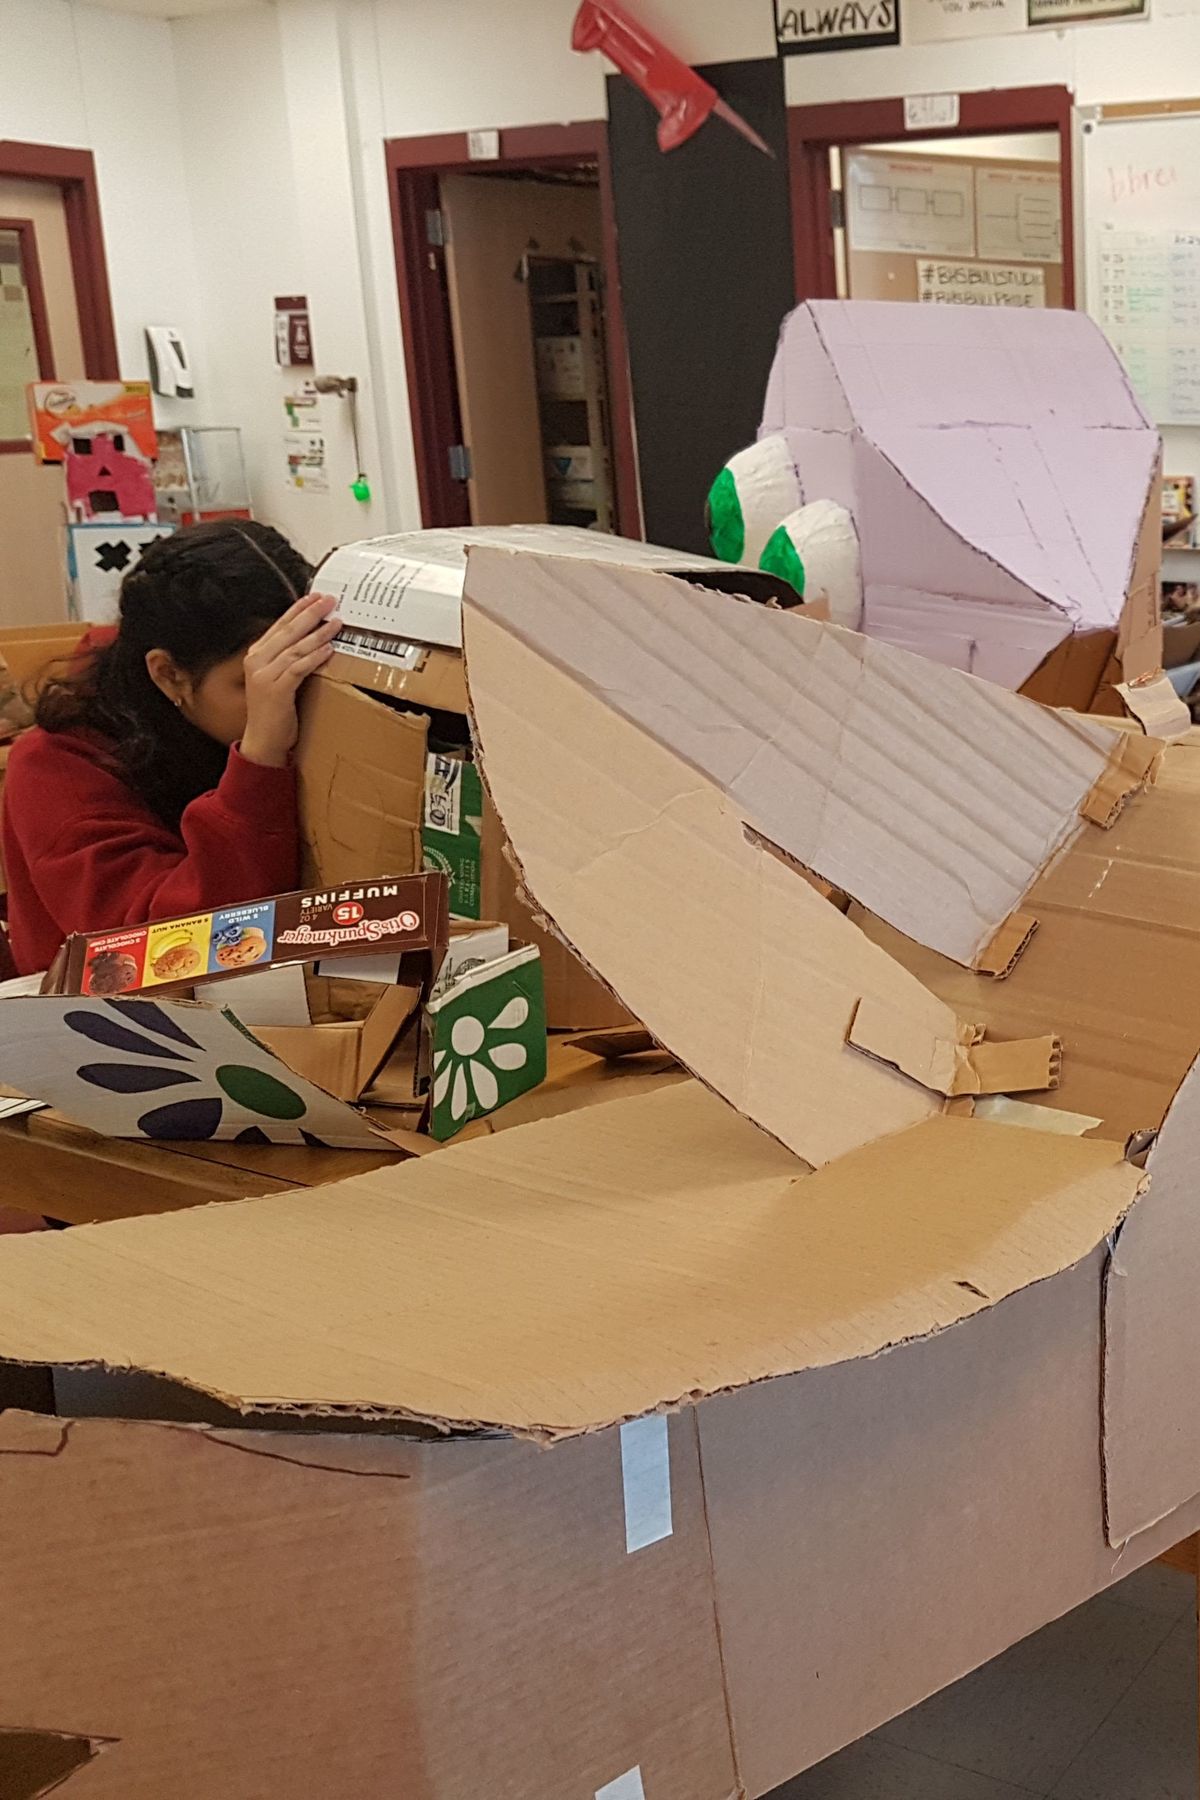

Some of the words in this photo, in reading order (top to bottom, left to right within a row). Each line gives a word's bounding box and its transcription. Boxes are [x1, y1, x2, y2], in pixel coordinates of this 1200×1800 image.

[781, 0, 892, 37] ALWAYS
[300, 885, 399, 908] MUFFINS
[218, 904, 270, 921] BLUEBERRY
[300, 904, 333, 915] VARIETY
[337, 905, 360, 921] 15
[171, 919, 203, 930] BANANA
[228, 914, 251, 925] WILD
[108, 928, 148, 945] CHOCOLATE
[151, 926, 169, 934] NUT
[94, 938, 135, 953] CHOCOLATE
